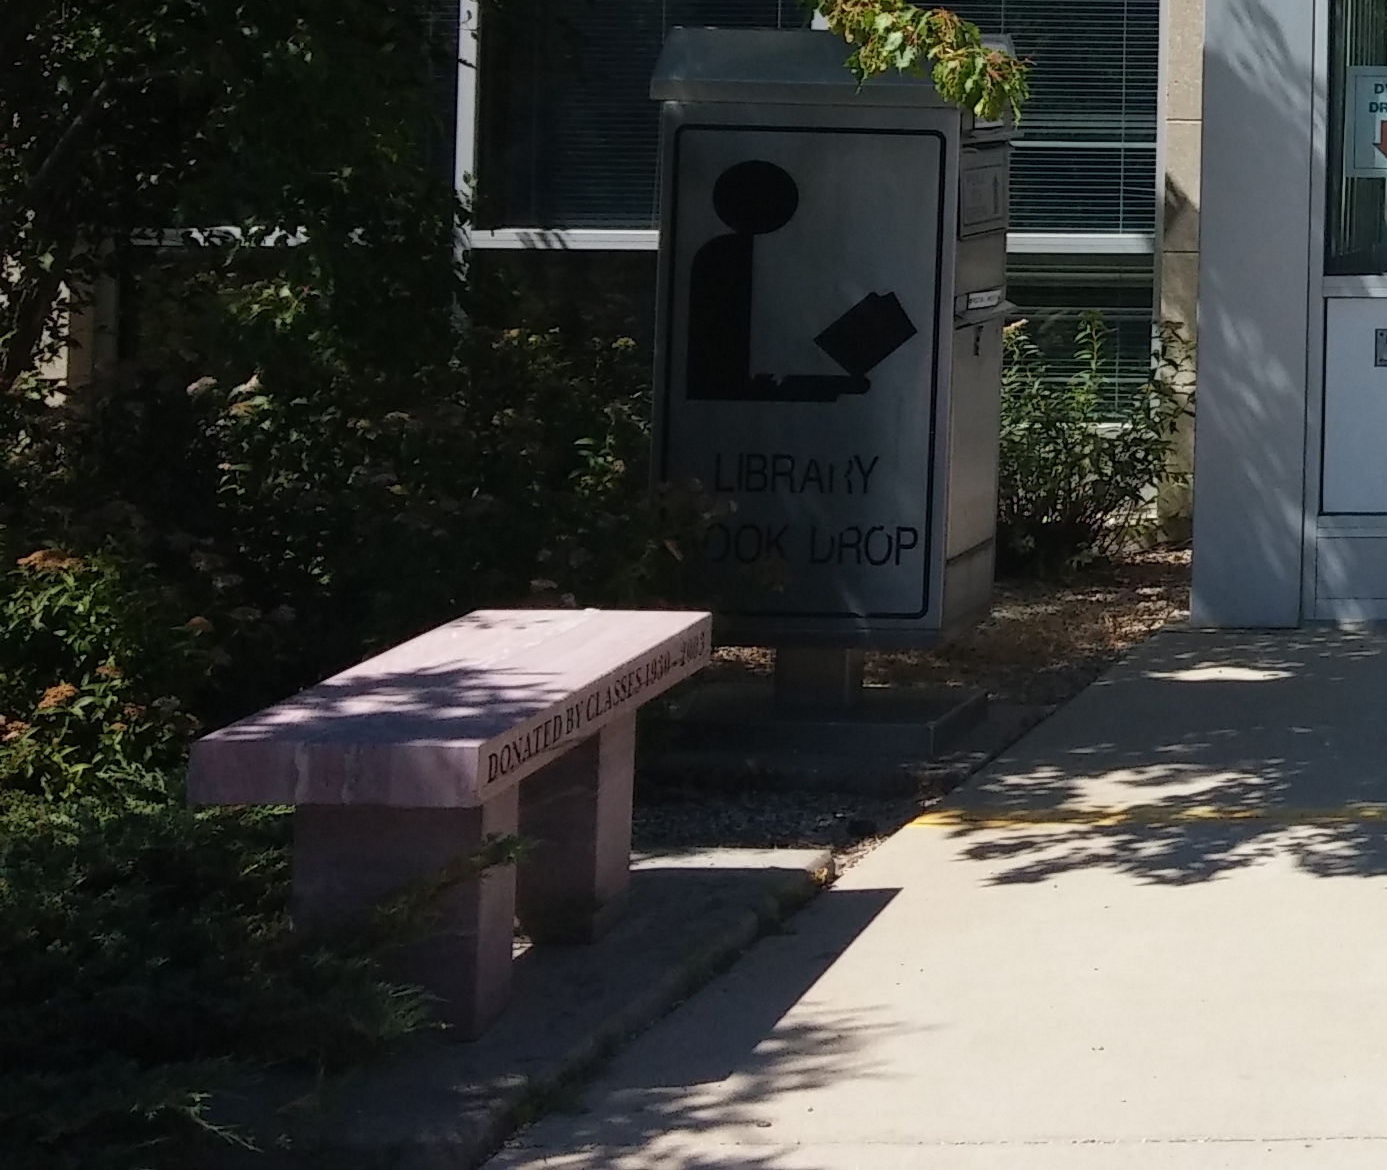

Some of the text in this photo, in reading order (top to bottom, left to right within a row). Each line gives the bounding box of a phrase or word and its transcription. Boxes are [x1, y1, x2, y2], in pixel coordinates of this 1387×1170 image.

[704, 523, 918, 566] OOK DROP
[487, 714, 563, 783] DONATED
[566, 699, 585, 735] BY
[586, 667, 643, 722] CLASSES
